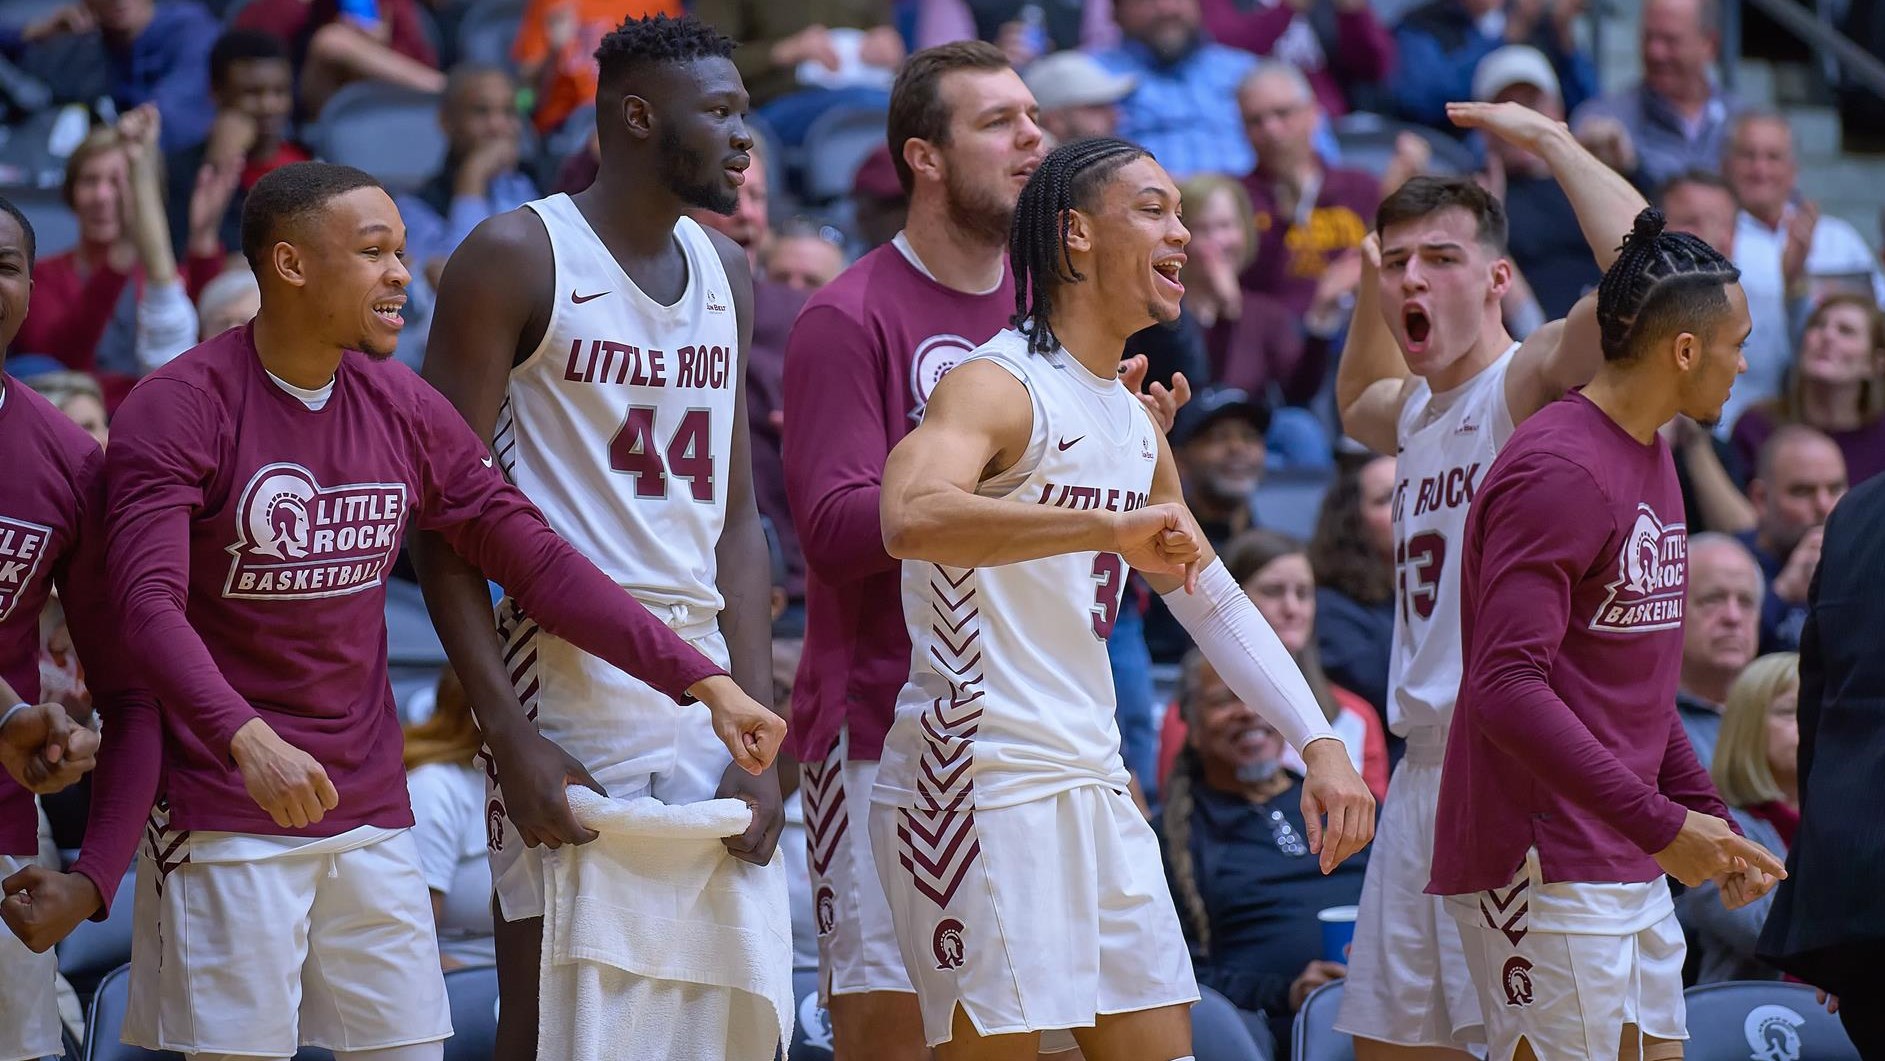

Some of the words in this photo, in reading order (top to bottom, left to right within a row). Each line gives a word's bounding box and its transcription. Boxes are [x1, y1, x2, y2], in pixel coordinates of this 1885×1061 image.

[564, 339, 667, 388] LITTLE
[606, 403, 716, 504] 44
[1413, 462, 1480, 517] ROCK
[315, 494, 398, 526] LITTLE
[312, 523, 396, 554] ROCK
[237, 560, 381, 591] BASKETBALL
[1654, 562, 1685, 590] ROC
[1089, 551, 1123, 641] 3
[1604, 598, 1683, 625] BASKETBAL
